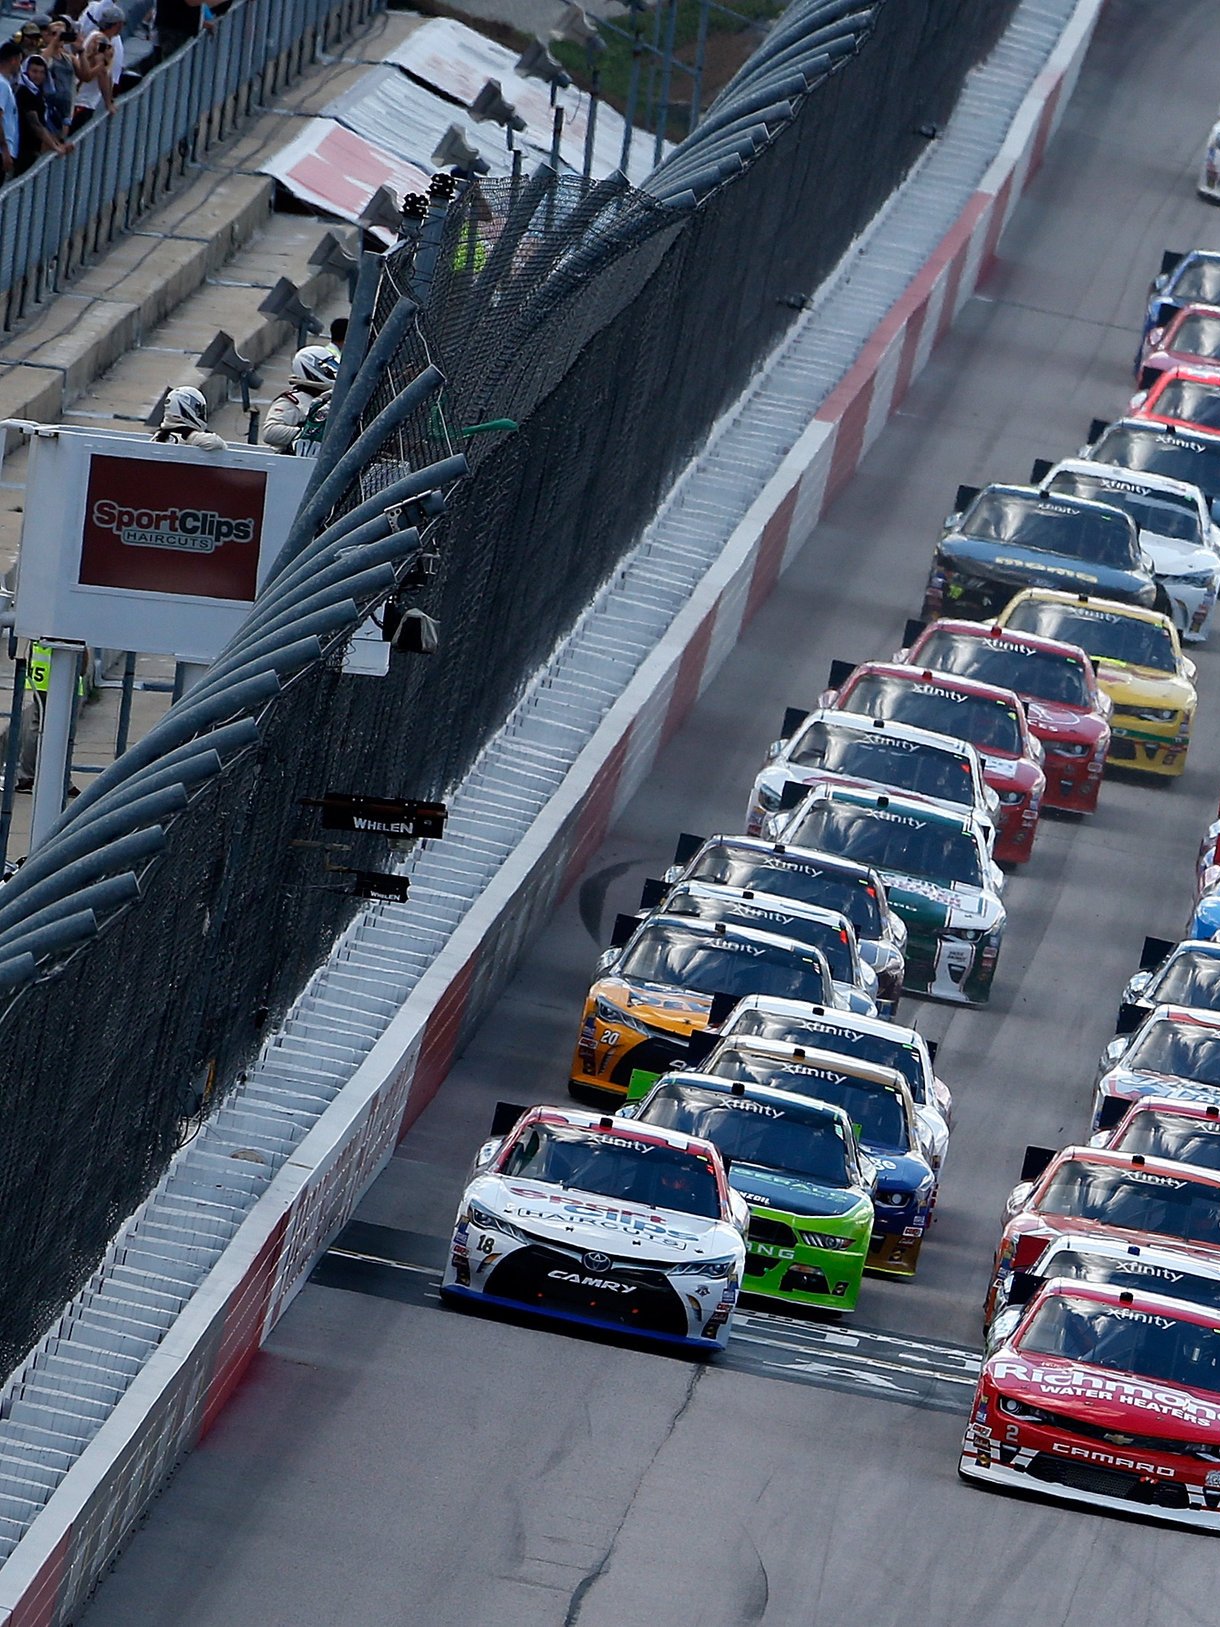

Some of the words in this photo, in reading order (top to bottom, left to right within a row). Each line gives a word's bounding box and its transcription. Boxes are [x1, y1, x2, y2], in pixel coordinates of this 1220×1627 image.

[1155, 434, 1206, 453] xfinity
[1101, 478, 1150, 496] xfinity
[93, 500, 255, 544] SportClips
[126, 530, 209, 549] HAIRCUTS
[982, 637, 1037, 657] xfinity
[912, 682, 969, 704] xfinity
[863, 732, 921, 752] xfinity
[353, 816, 414, 835] WHELEN
[866, 807, 927, 831] xfinity
[764, 857, 823, 878] xfinity
[370, 890, 401, 901] WHELEN
[732, 904, 794, 924] xfinity
[705, 936, 767, 957] xfinity
[600, 1029, 621, 1046] 20
[800, 1020, 864, 1043] xfinity
[781, 1062, 848, 1085] xfinity
[720, 1097, 785, 1119] xfinity
[1120, 1168, 1188, 1190] xfinity
[739, 1191, 771, 1206] NZOIL
[476, 1234, 495, 1255] 18
[547, 1269, 638, 1294] CAMRY
[1116, 1259, 1184, 1283] xfinity
[1106, 1306, 1177, 1330] xfinity
[1040, 1384, 1113, 1401] WATER
[1119, 1394, 1211, 1428] HEATERS
[1004, 1424, 1020, 1442] 2
[1052, 1442, 1175, 1477] CAMARO
